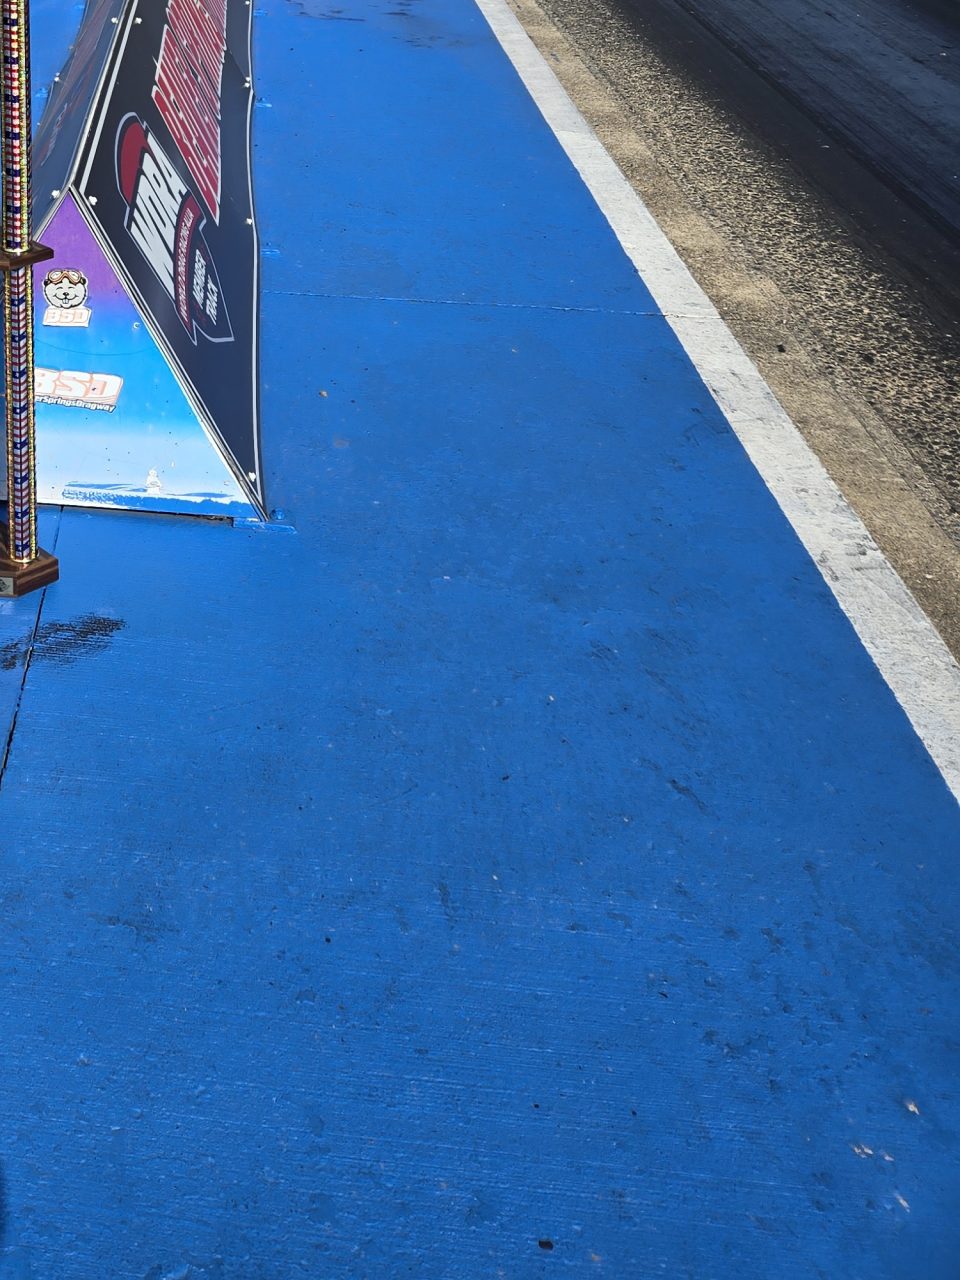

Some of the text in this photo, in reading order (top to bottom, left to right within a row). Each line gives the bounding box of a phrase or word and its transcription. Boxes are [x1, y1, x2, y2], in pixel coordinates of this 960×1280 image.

[130, 131, 188, 300] WDRA
[192, 248, 207, 309] MEMBER
[205, 273, 218, 326] TRACK
[46, 307, 91, 324] BSD
